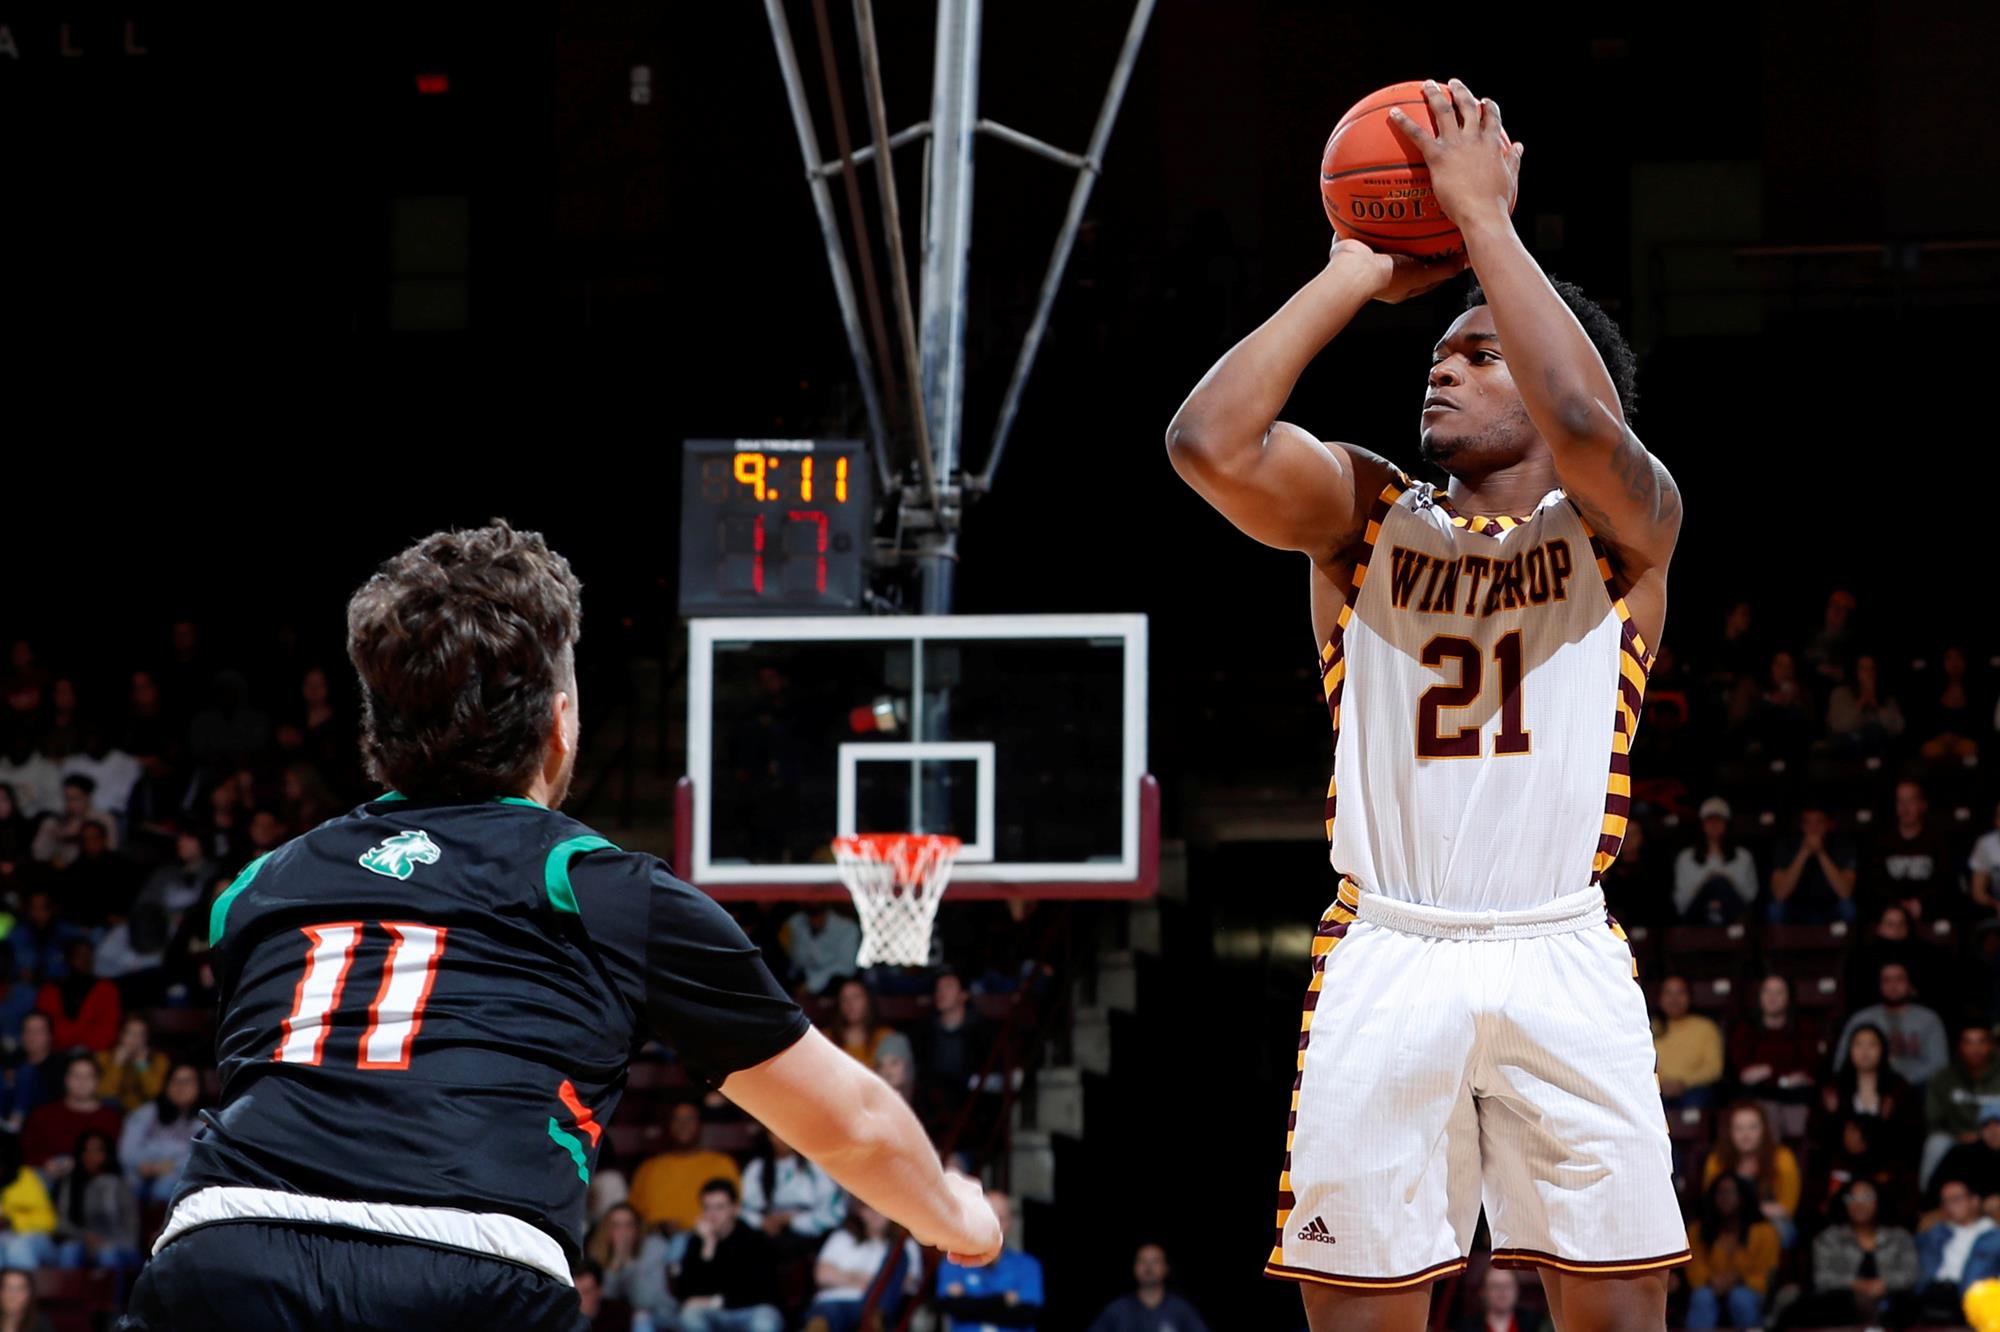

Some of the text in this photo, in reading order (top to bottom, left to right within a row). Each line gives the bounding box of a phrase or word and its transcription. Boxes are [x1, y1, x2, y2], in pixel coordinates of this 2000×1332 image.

[733, 452, 849, 502] 9:11
[752, 510, 830, 594] 17
[1391, 537, 1572, 618] WINTHROP
[1414, 628, 1533, 760] 21
[271, 920, 449, 1070] 11
[1297, 1231, 1336, 1245] adidas
